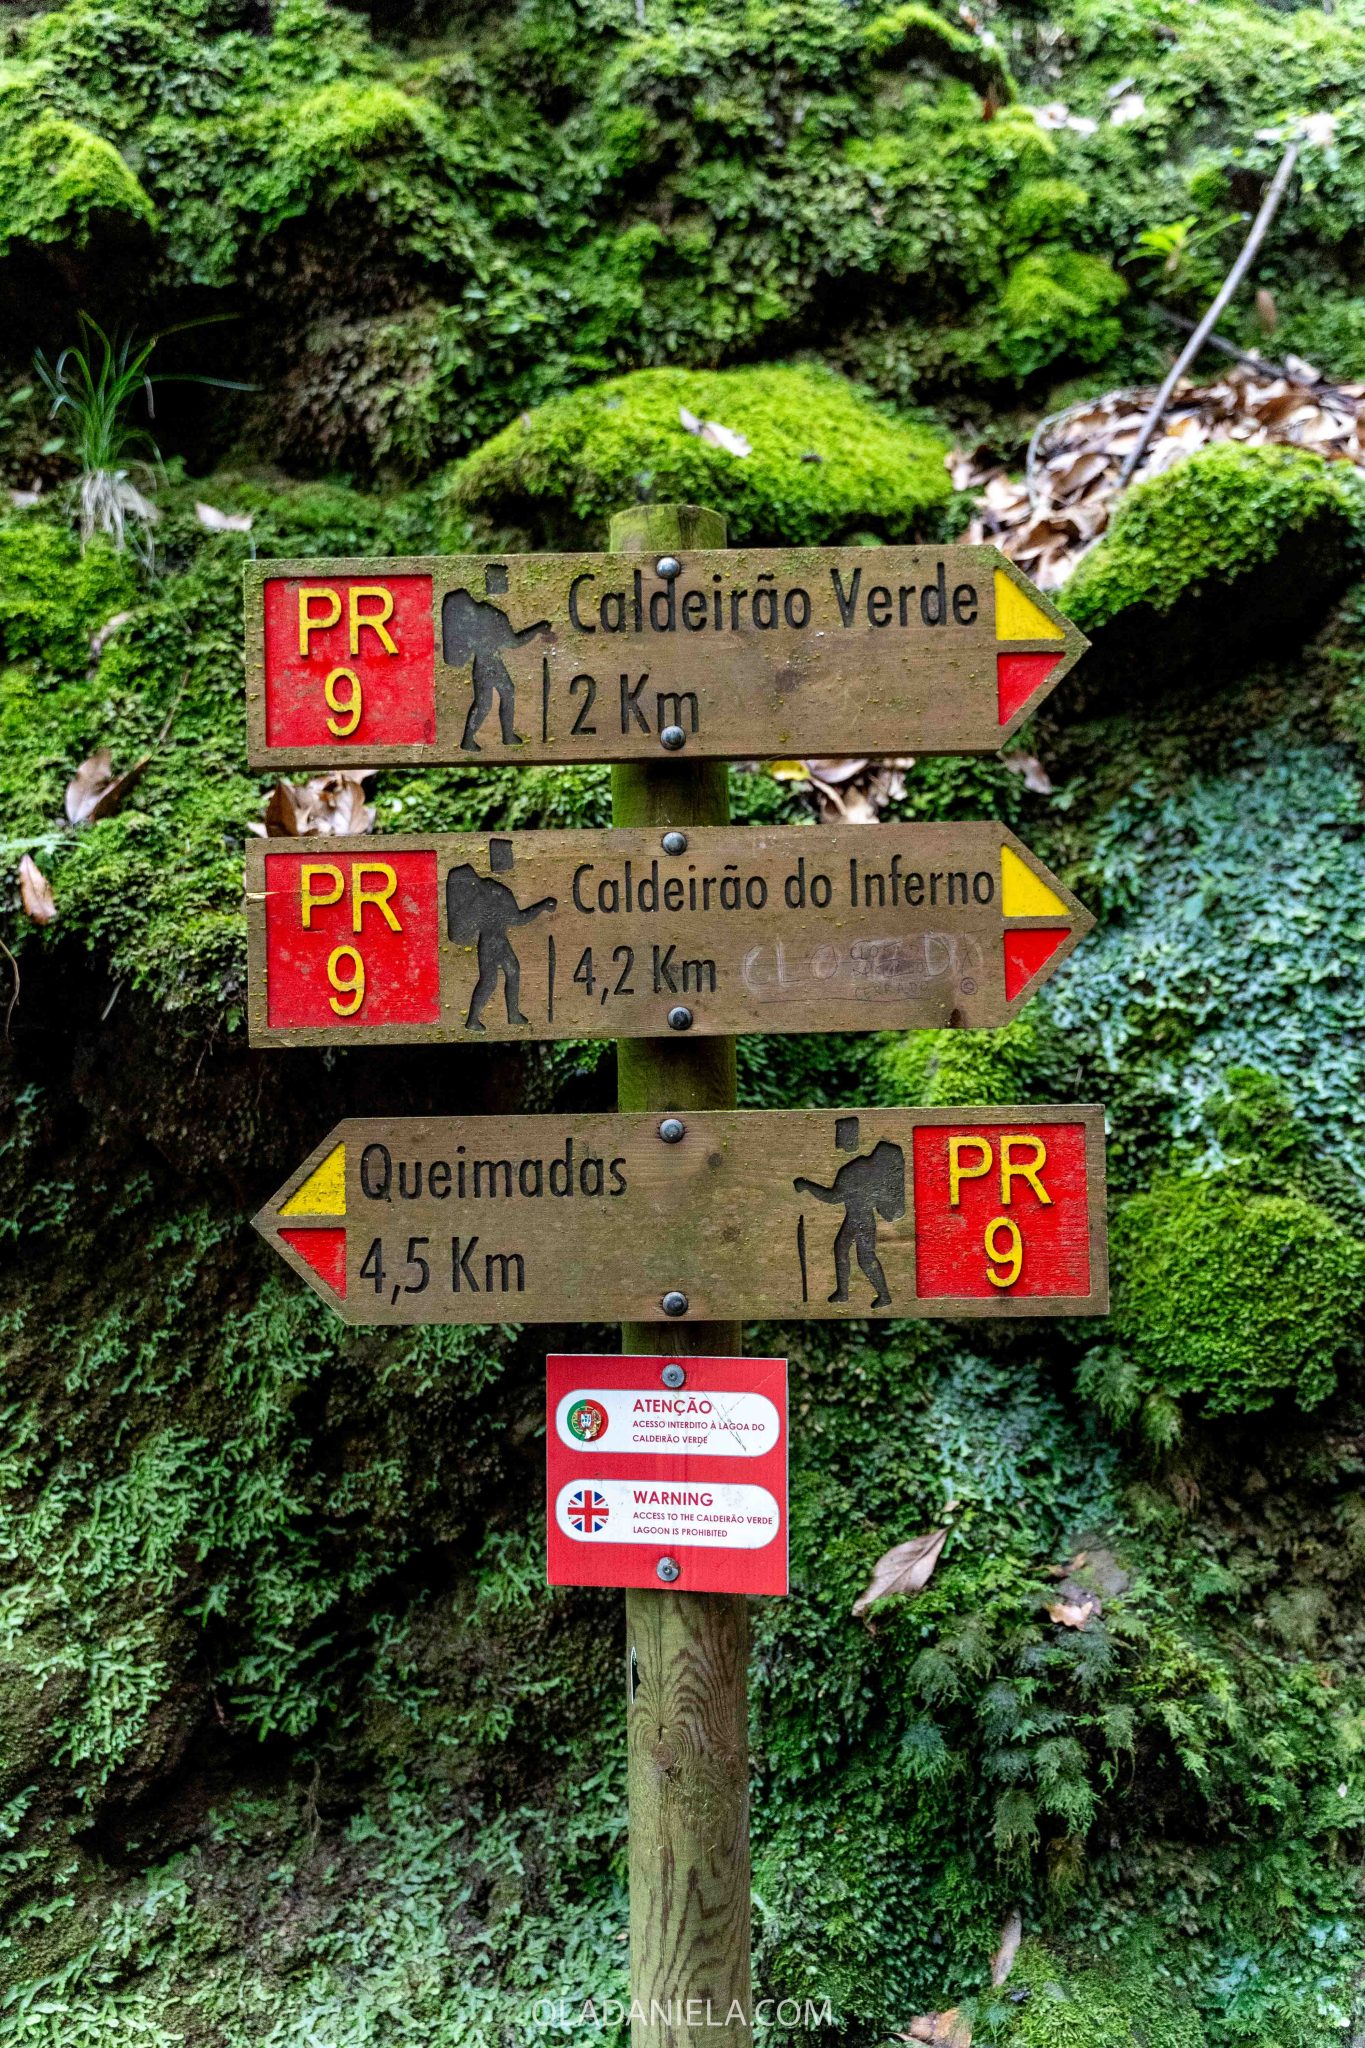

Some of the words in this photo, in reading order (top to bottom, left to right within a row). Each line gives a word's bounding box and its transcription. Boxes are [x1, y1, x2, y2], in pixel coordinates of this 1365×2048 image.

[298, 586, 398, 656] PR
[568, 567, 811, 634] Caldeirão
[829, 561, 978, 628] Verde
[324, 667, 363, 737] 9
[569, 674, 597, 735] 2
[620, 672, 699, 735] Km
[300, 862, 403, 933] PR
[573, 859, 768, 914] Caldeirão
[785, 857, 832, 909] do
[849, 853, 994, 907] Inferno
[327, 945, 365, 1017] 9
[573, 944, 635, 1005] 4,2
[653, 944, 717, 994] Km
[360, 1137, 628, 1203] Queimadas
[949, 1135, 1053, 1206] PR
[359, 1237, 430, 1305] 4,5
[451, 1236, 526, 1293] Km
[984, 1216, 1023, 1288] 9
[632, 1397, 713, 1416] ATENÇÃO
[632, 1420, 666, 1429] ACESSO
[667, 1421, 708, 1430] INTERDITO
[710, 1420, 717, 1430] À
[718, 1422, 750, 1431] LAGOA
[752, 1423, 765, 1432] DO
[632, 1434, 680, 1444] CALDEIRÃO
[682, 1436, 708, 1444] VERDE
[633, 1491, 714, 1507] WARNING
[633, 1512, 665, 1521] ACCESS
[667, 1513, 679, 1521] TO
[680, 1513, 695, 1522] THE
[696, 1513, 745, 1524] CALDEIRÃO
[746, 1516, 773, 1525] VERDE
[633, 1526, 670, 1535] LAGOON
[672, 1527, 680, 1536] IS
[681, 1528, 728, 1538] PROHIBITED
